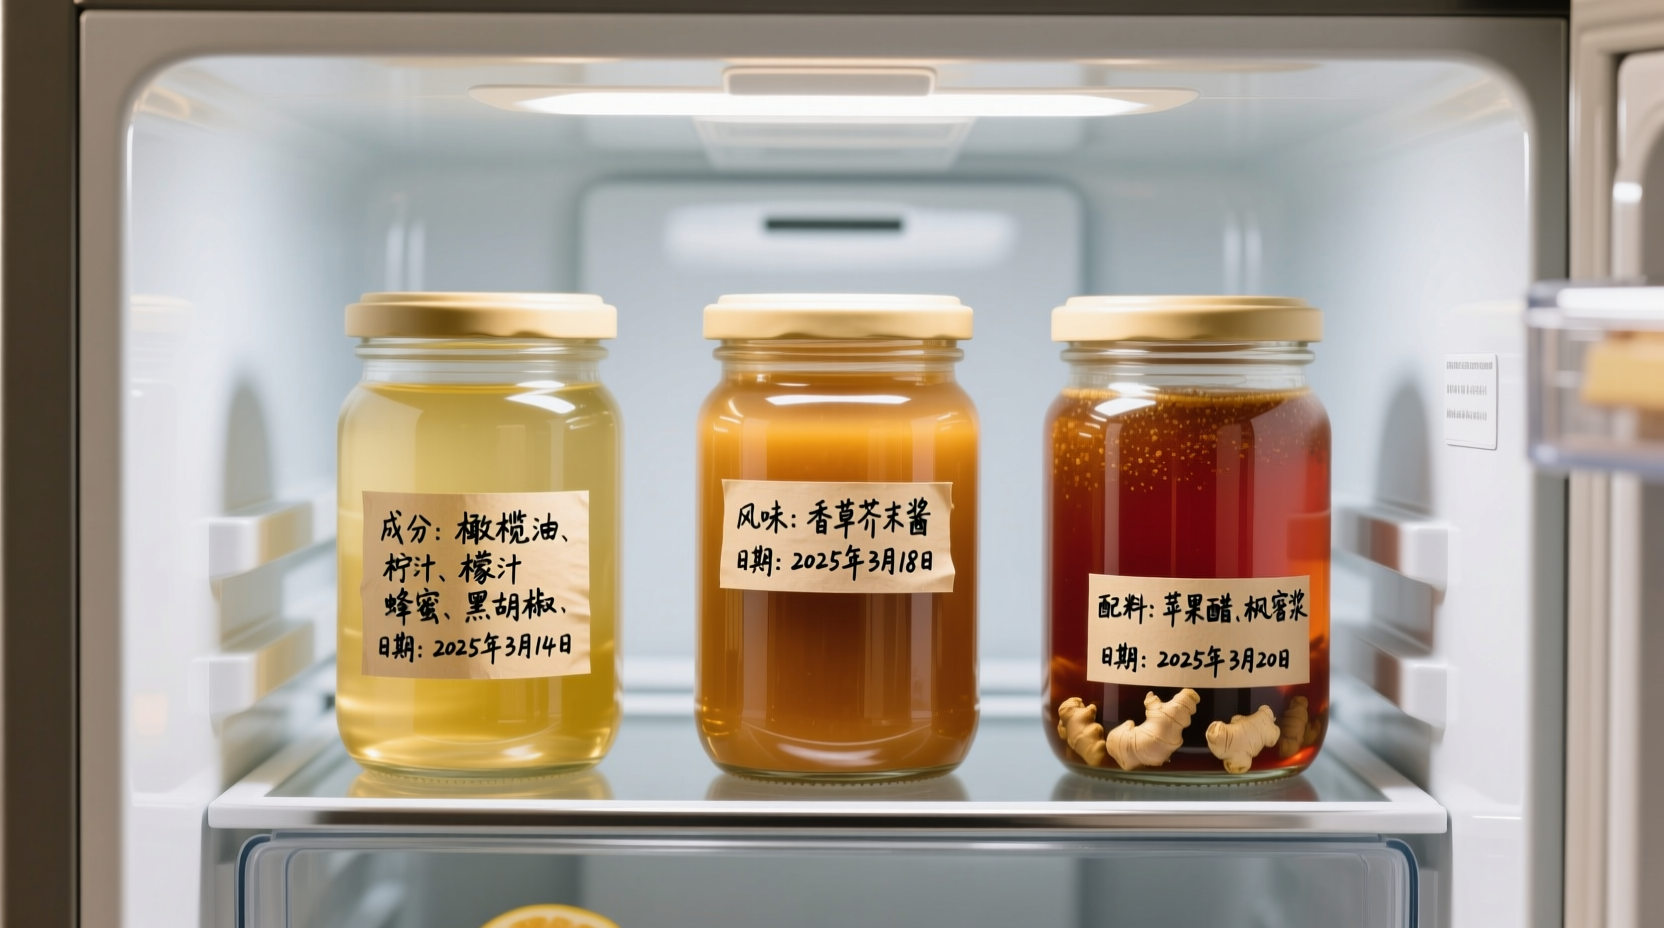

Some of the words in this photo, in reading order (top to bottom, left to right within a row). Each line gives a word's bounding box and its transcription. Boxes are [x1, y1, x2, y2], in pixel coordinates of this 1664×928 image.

[736, 544, 933, 582] 日期：2025年3月18日
[378, 631, 572, 665] 日期：2025年3月14日
[1101, 642, 1290, 679] 日期：2025年3月20日
